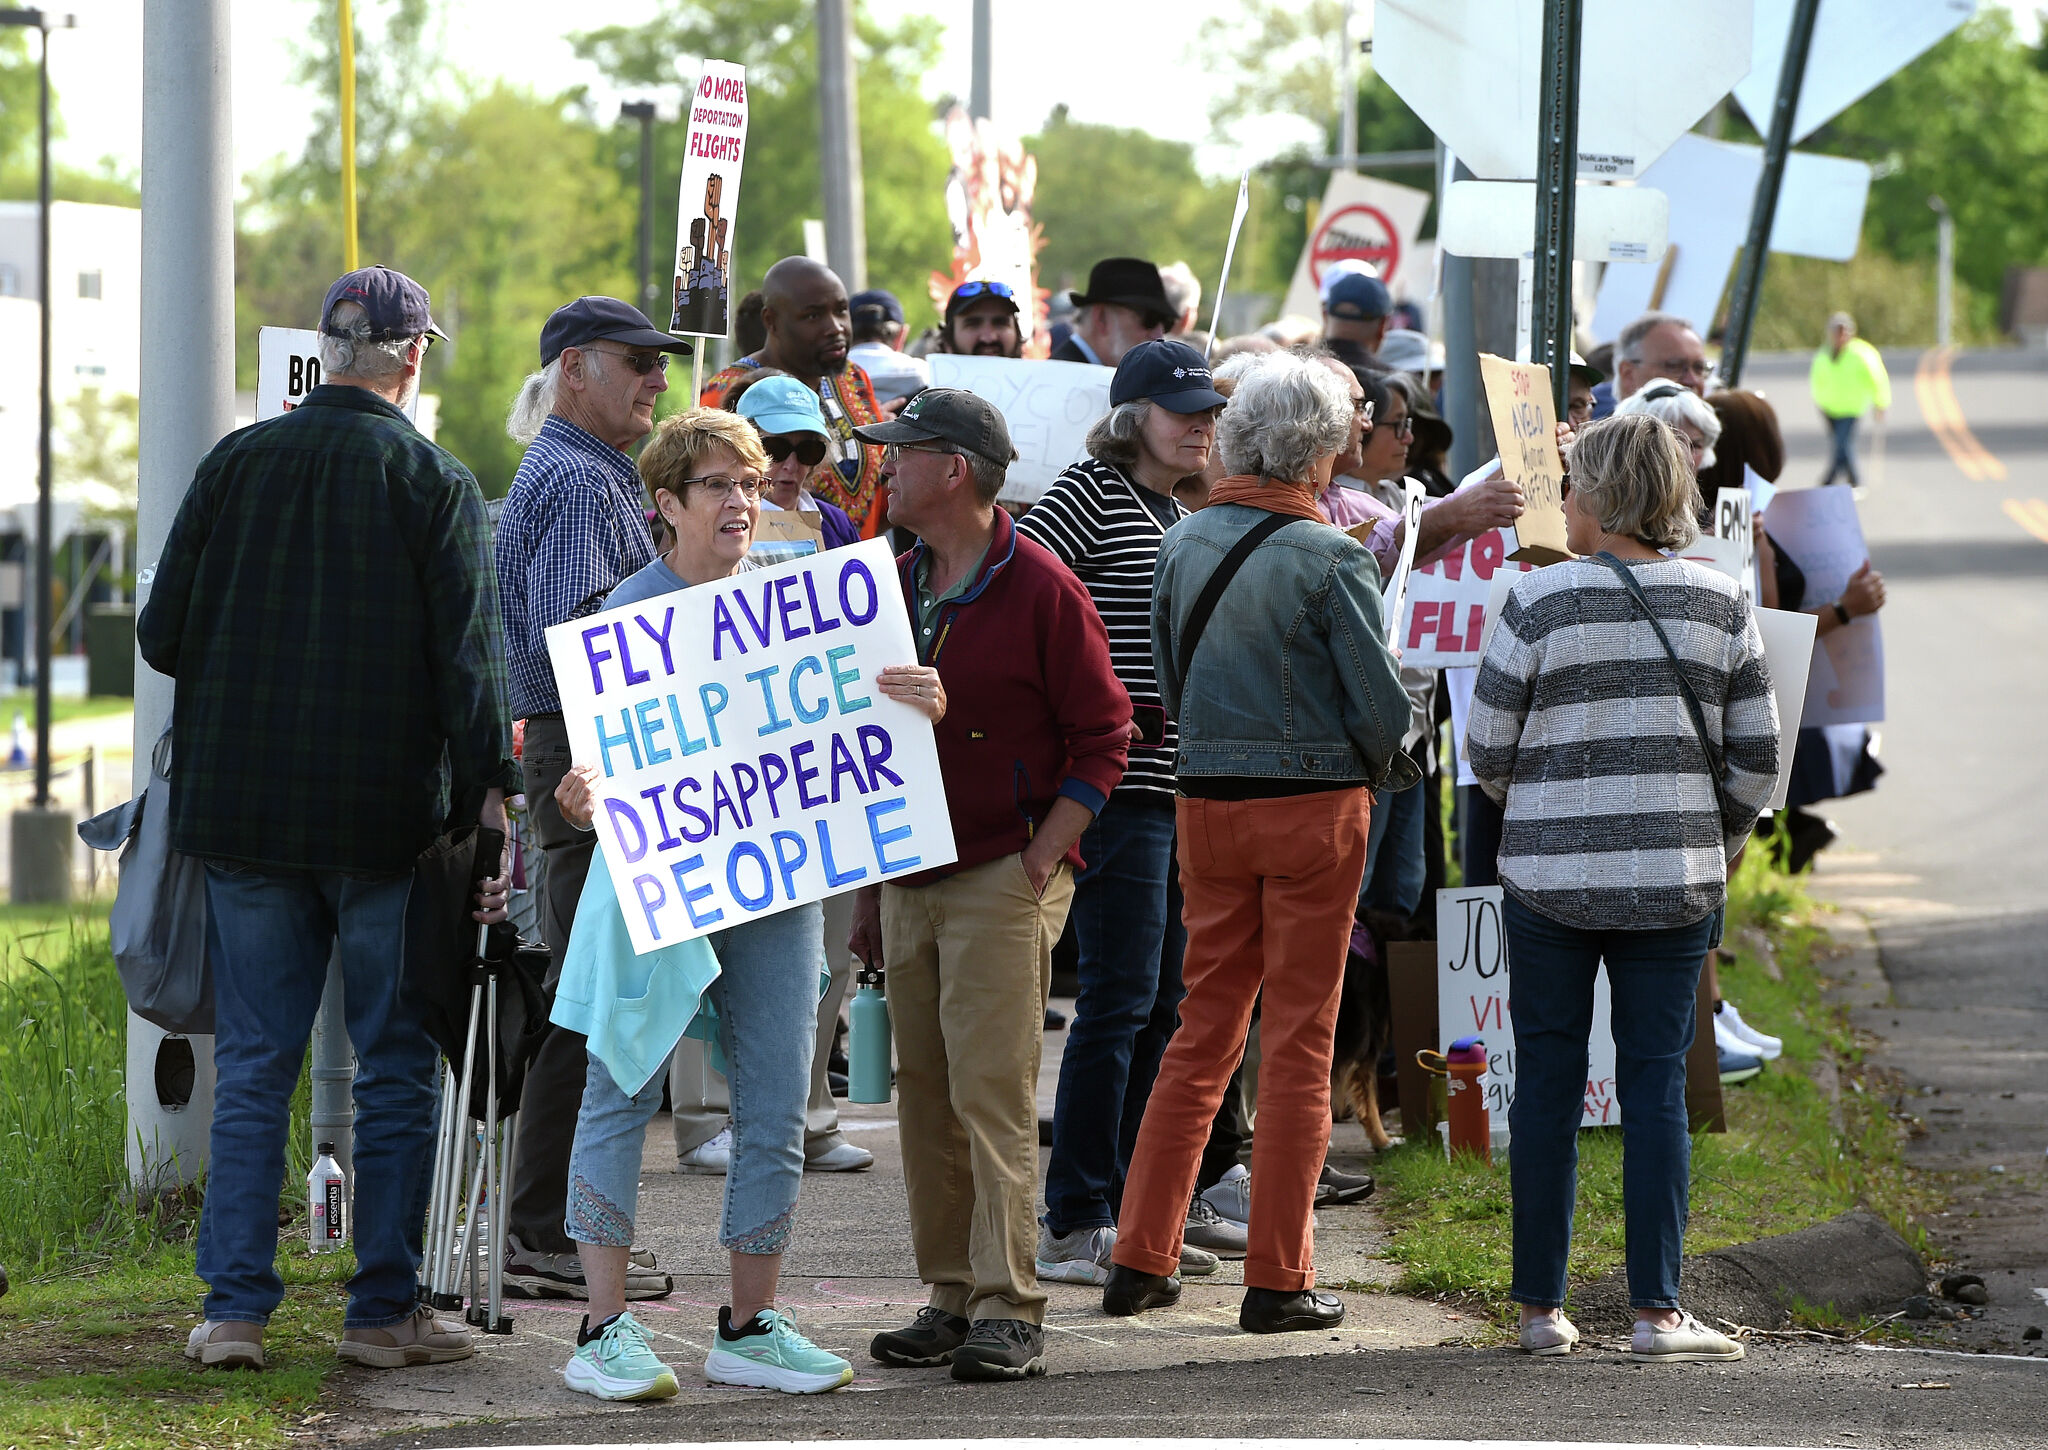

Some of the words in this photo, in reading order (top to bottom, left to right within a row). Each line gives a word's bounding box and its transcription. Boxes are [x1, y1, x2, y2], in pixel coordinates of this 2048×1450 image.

[697, 75, 712, 98] NO
[714, 77, 744, 104] MORE
[693, 108, 743, 128] DEPORTATION
[690, 131, 741, 162] FLIGHTS
[1579, 152, 1608, 163] Vulcan
[1612, 156, 1634, 165] Signs
[1511, 370, 1530, 397] STOP
[1512, 402, 1544, 439] AVELO
[581, 606, 675, 695] FLY
[713, 558, 879, 661] AVELO
[1407, 601, 1487, 652] FLI
[594, 682, 729, 777] HELP
[744, 644, 872, 738] ICE
[604, 724, 905, 863] DISAPPEAR
[632, 796, 922, 940] PEOPLE
[330, 1186, 338, 1225] essentia
